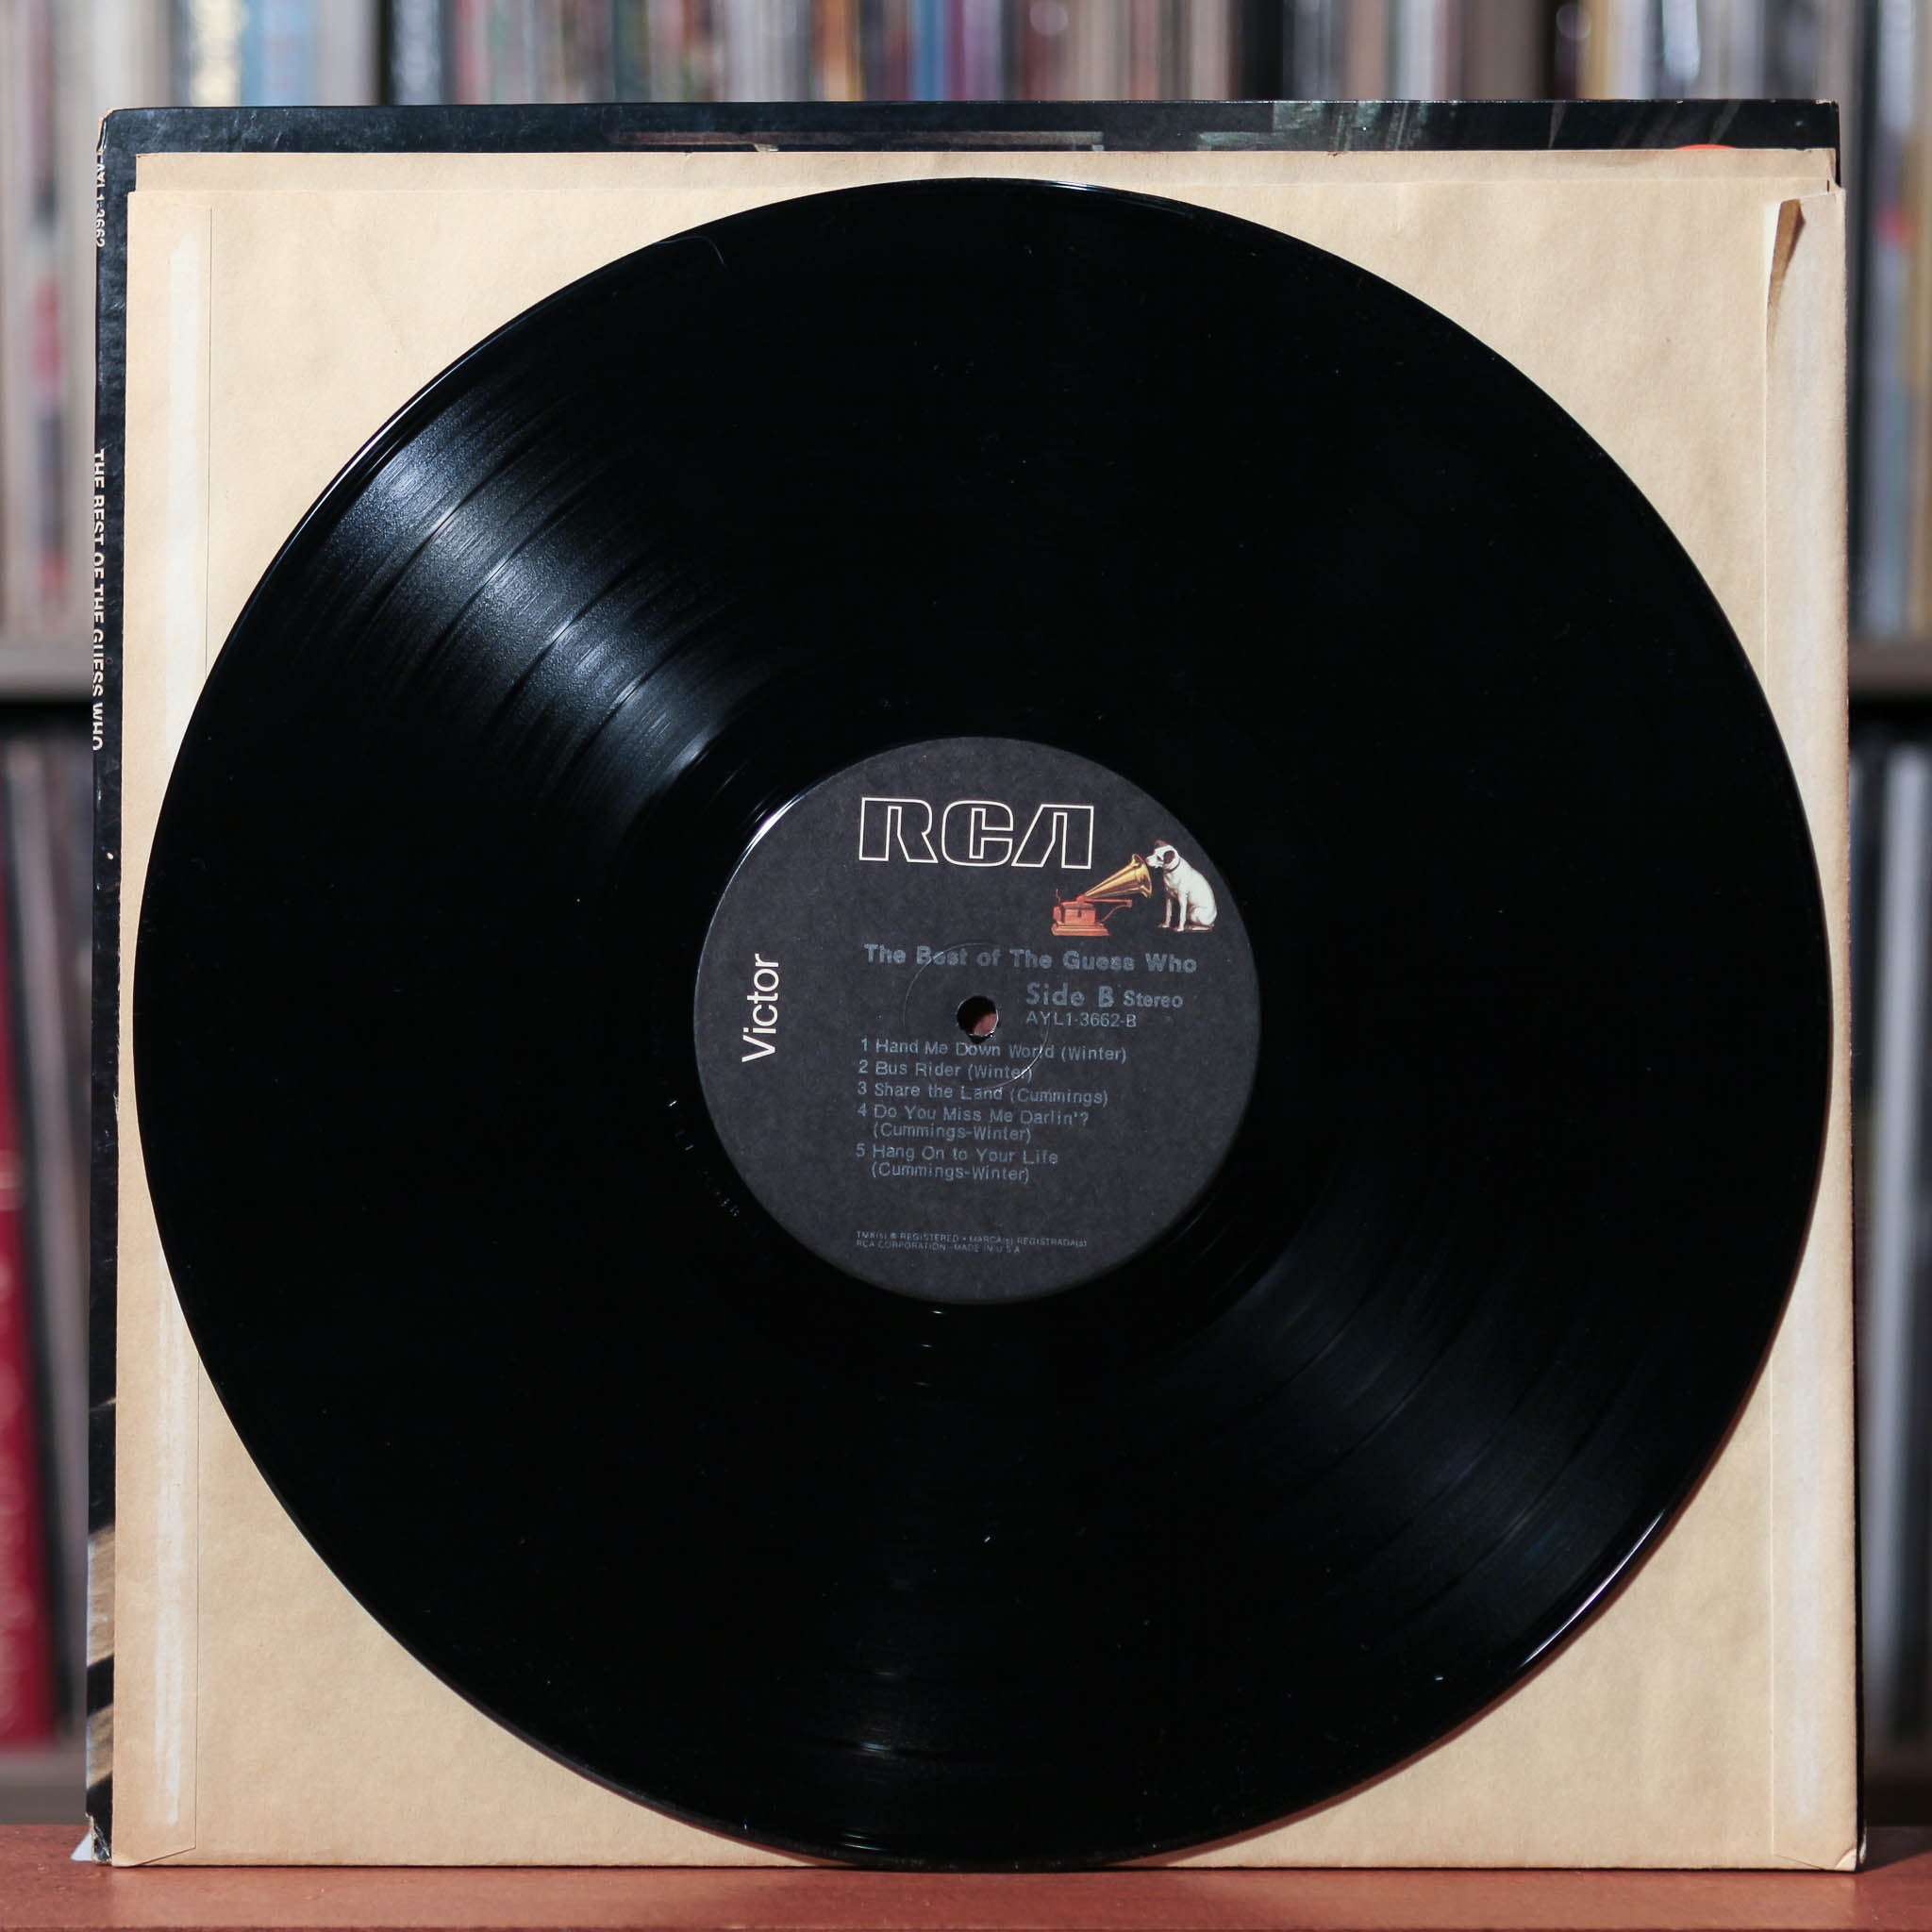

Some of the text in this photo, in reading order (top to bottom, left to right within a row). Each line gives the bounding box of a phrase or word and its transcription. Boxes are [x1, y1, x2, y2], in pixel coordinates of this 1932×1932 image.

[94, 449, 105, 488] THE
[94, 495, 105, 545] BEST
[94, 584, 105, 624] THE
[859, 797, 1094, 868] RCA
[863, 943, 1197, 974] The Best of The Guess Who
[741, 953, 779, 1062] Victor
[1026, 982, 1183, 1008] Side B Stereo
[1026, 1010, 1137, 1027] AYL1-3662-B
[860, 1038, 868, 1052] 1
[875, 1039, 919, 1054] Hand
[924, 1041, 949, 1056] Me
[956, 1041, 1001, 1057] Down
[1061, 1045, 1126, 1064] (Winter)
[858, 1059, 868, 1074] 2
[874, 1060, 908, 1075] Bus
[915, 1061, 962, 1077] Rider
[858, 1081, 1108, 1108] 3 Share the Land (Cummings)
[858, 1102, 1090, 1127] 4 Do You Miss Me Darlin'?
[873, 1122, 1032, 1145] (Cummings-Winter)
[856, 1142, 1058, 1165] 5 Hang On to Your Life
[871, 1161, 1029, 1185] (Cummings-Winter)
[857, 1240, 875, 1248] RCA
[900, 1232, 959, 1243] REGISTERED
